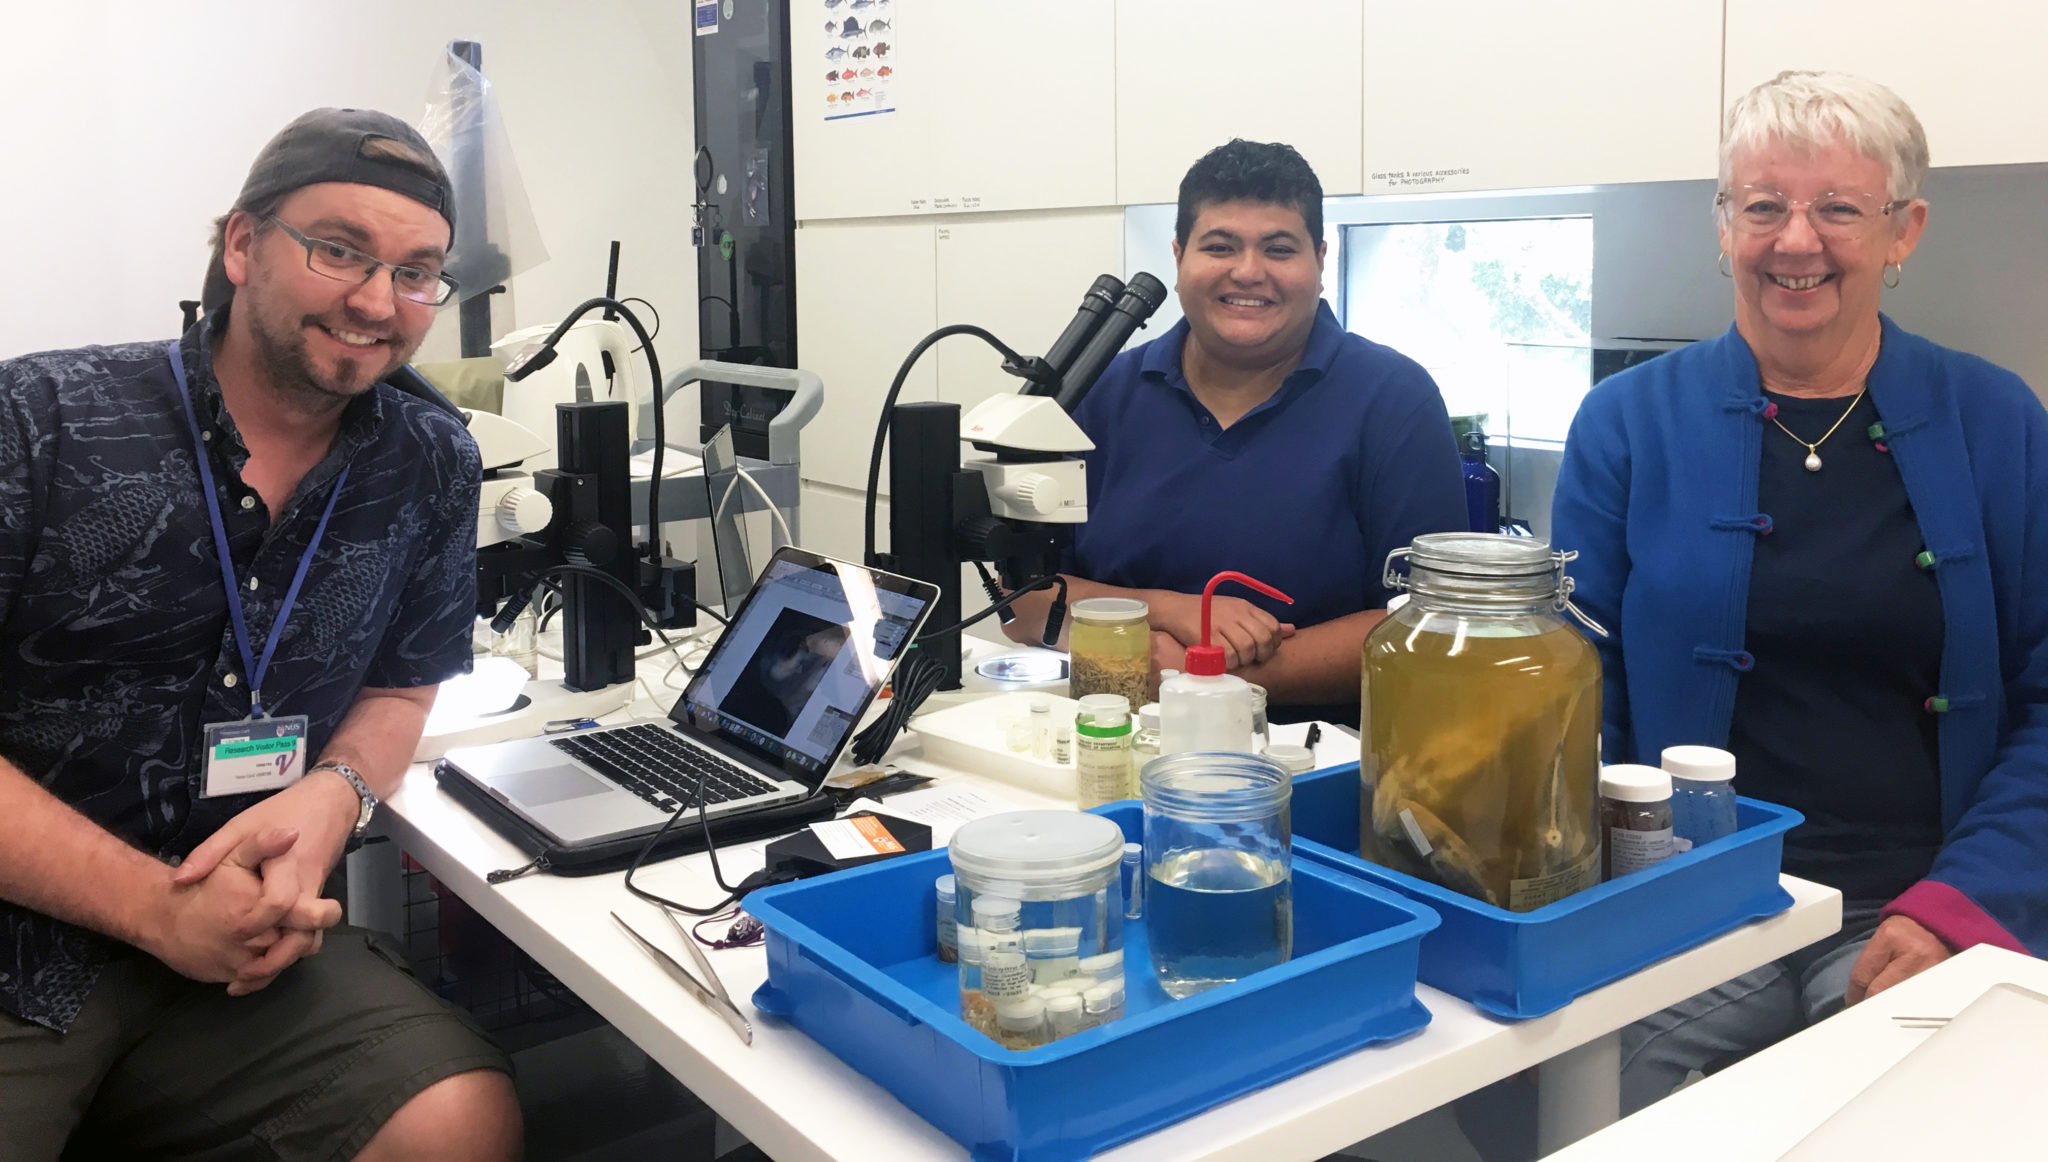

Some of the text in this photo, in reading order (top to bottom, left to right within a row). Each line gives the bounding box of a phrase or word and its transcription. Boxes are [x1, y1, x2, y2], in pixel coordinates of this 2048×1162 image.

[1388, 177, 1445, 187] for PHOTOGRAPHY
[739, 403, 766, 421] Cabinet
[225, 745, 255, 754] Research
[256, 742, 275, 751] Visitor
[275, 740, 291, 749] Pass
